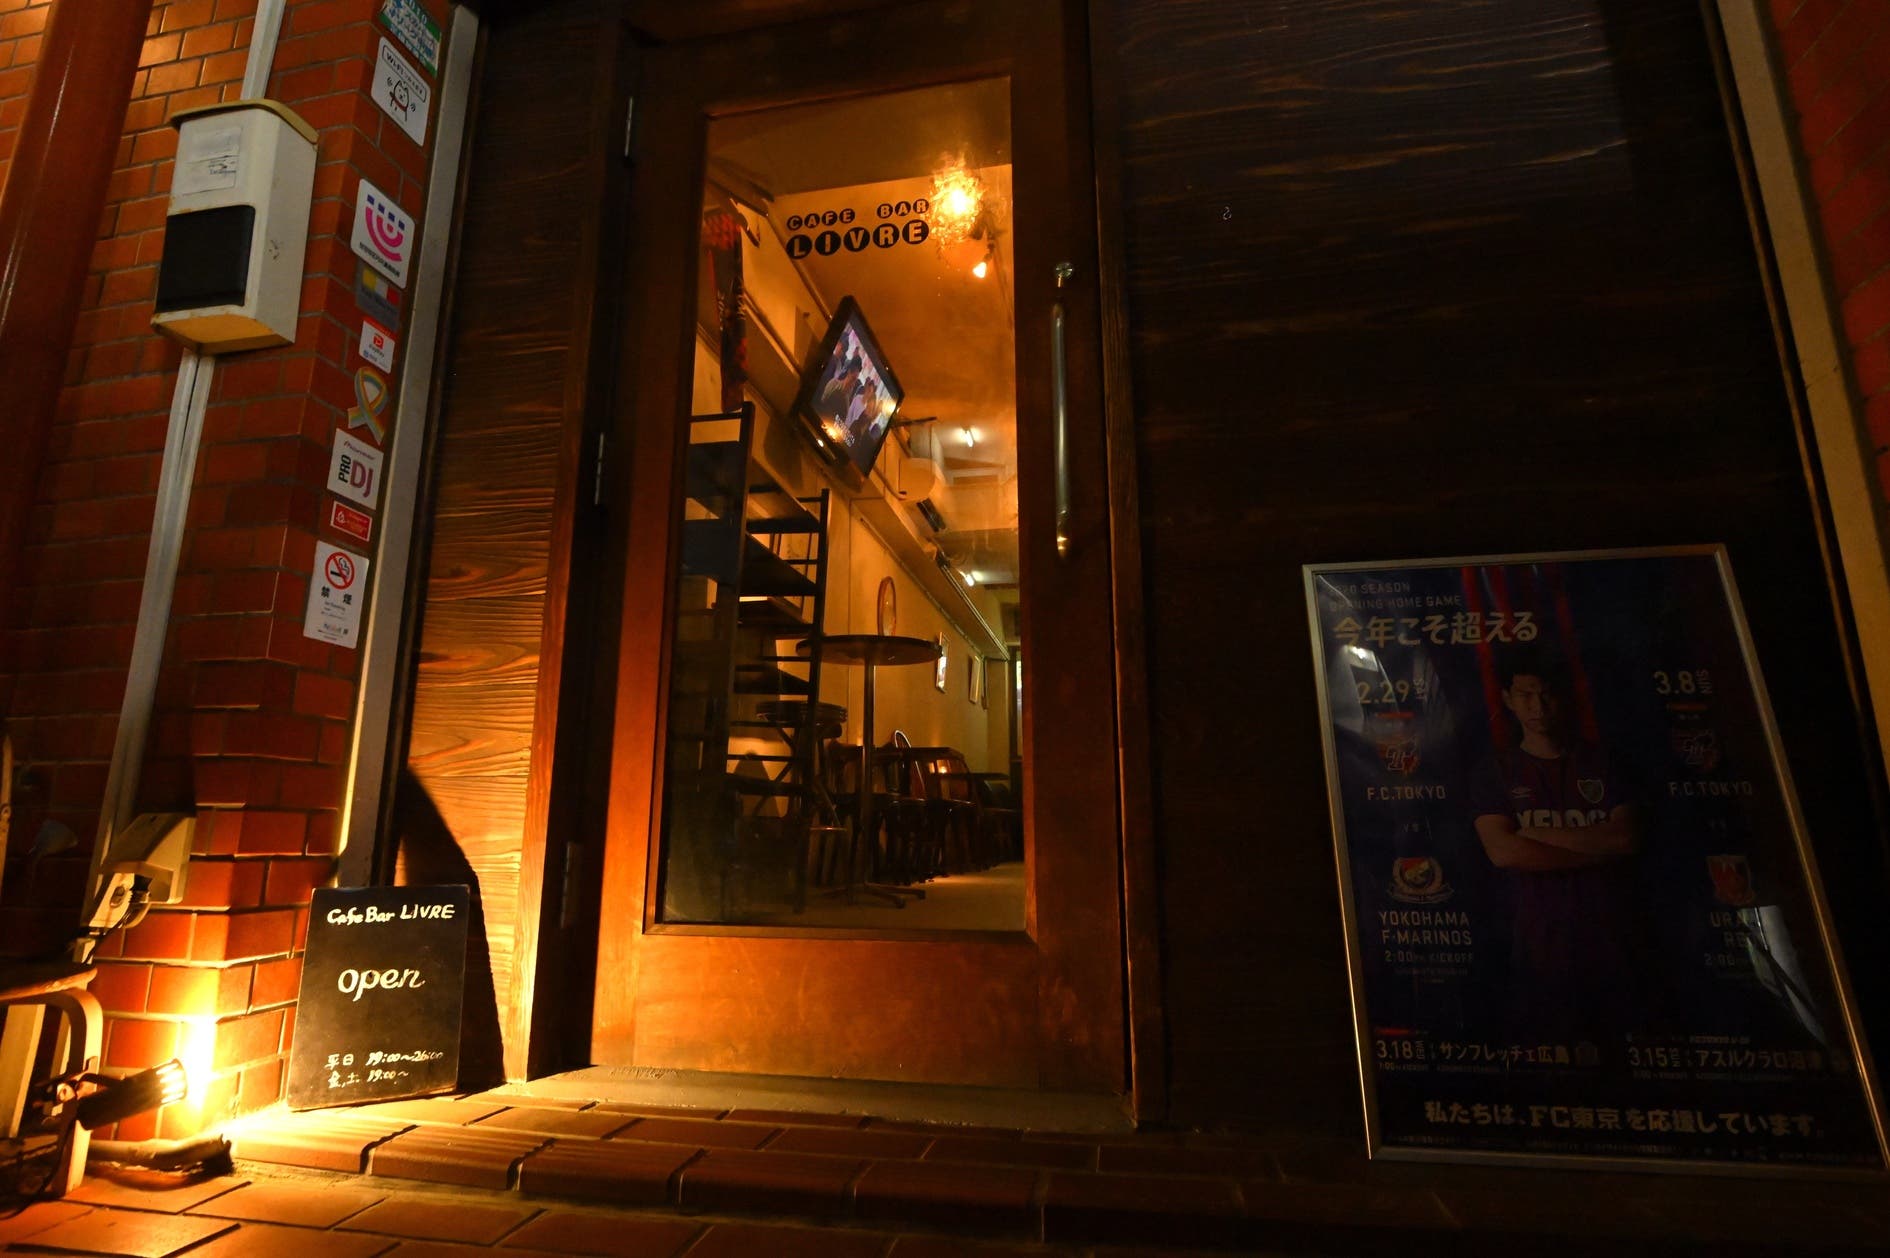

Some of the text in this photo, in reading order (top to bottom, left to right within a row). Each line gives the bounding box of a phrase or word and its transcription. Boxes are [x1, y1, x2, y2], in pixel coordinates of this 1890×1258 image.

[787, 199, 929, 230] CAFE BAR
[787, 220, 928, 258] LIVRE
[338, 454, 351, 483] PRO
[349, 460, 374, 498] DJ
[1360, 582, 1410, 594] SEASON
[1333, 611, 1538, 648] 今年こそ超える
[1653, 670, 1696, 695] 3.8
[365, 906, 395, 923] Bar
[400, 904, 456, 919] LIVRE
[1378, 910, 1470, 927] YOKOHAMA
[1376, 1040, 1413, 1060] 3.18
[1628, 1046, 1667, 1068] 3.15
